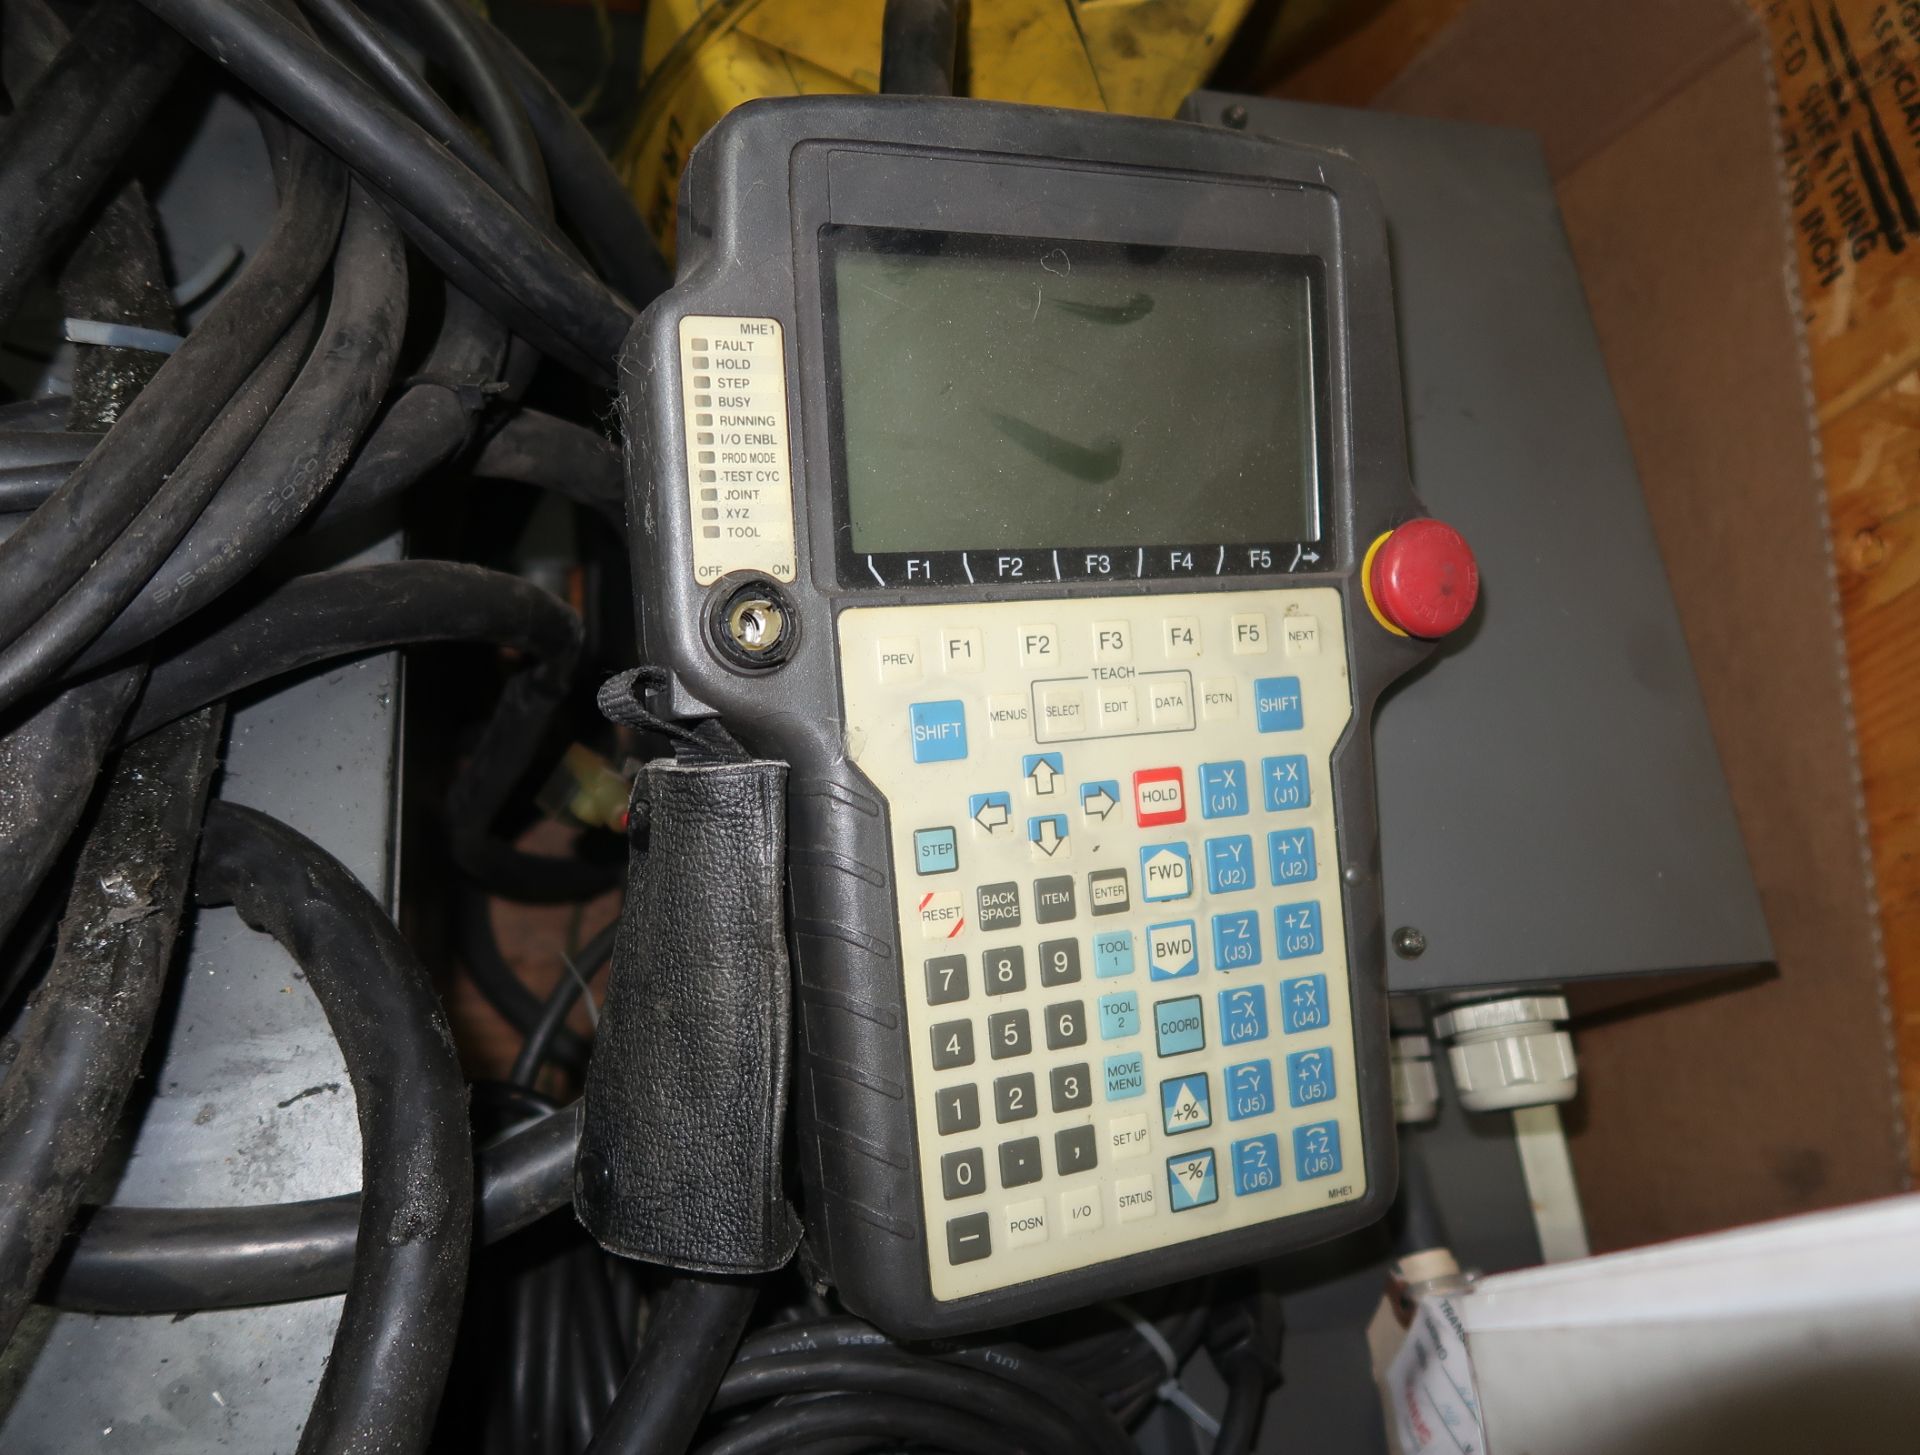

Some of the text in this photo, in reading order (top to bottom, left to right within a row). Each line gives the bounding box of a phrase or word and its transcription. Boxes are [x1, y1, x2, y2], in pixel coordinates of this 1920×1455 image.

[740, 324, 775, 336] MHE1
[715, 341, 754, 352] FAULT
[717, 359, 750, 370] HOLD
[718, 378, 750, 389] STEP
[718, 397, 750, 408] BUSY
[720, 416, 776, 427] RUNNING
[721, 434, 777, 445] I/O ENBL
[722, 453, 776, 464] PROD MODE
[724, 470, 780, 482] TEST CYC
[725, 490, 760, 500] JOINT
[727, 509, 750, 519] XYZ
[727, 527, 760, 538] TOOL
[699, 566, 722, 577] OFF
[772, 565, 790, 575] ON
[907, 551, 1271, 580] F1 F2 F3 F4 F5
[882, 624, 1314, 667] PREV F1 F2 F3 F4 F5 NEXT
[1091, 667, 1135, 680] TEACH
[1105, 700, 1128, 713] EDIT
[1155, 696, 1183, 709] DATA
[1205, 692, 1232, 705] FCTN
[1260, 696, 1298, 712] SHIFT
[990, 709, 1027, 722] MENUS
[1046, 704, 1080, 718] SELECT
[915, 723, 960, 741] SHIFT
[1273, 765, 1297, 781] +X
[1142, 788, 1177, 803] HOLD
[1212, 793, 1237, 812] (J1)
[1274, 787, 1299, 806] (J1)
[921, 843, 952, 857] STEP
[1279, 837, 1303, 855] +Y
[1149, 864, 1183, 880] FWD
[1218, 867, 1247, 885] (J2)
[1280, 860, 1308, 879] (J2)
[1041, 892, 1070, 905] ITEM
[1095, 884, 1124, 898] ENTER
[982, 892, 1016, 907] BACK
[922, 906, 960, 922] RESET
[980, 904, 1019, 920] SPACE
[1285, 910, 1311, 930] +Z
[1098, 941, 1129, 954] TOOL
[1156, 939, 1192, 957] BWD
[1286, 933, 1315, 952] (J3)
[1224, 942, 1253, 961] (J3)
[1053, 952, 1068, 973] 9
[1113, 957, 1118, 966] 1
[998, 960, 1013, 981] 8
[940, 970, 953, 991] 7
[1103, 1002, 1135, 1015] TOOL
[1292, 992, 1318, 1009] +X
[1059, 1015, 1073, 1036] 6
[1118, 1017, 1125, 1028] 2
[1160, 1017, 1200, 1035] COORD
[1292, 1009, 1321, 1027] (J4)
[1004, 1024, 1018, 1046] 5
[1231, 1021, 1259, 1040] (J4)
[946, 1034, 960, 1056] 4
[1107, 1062, 1141, 1077] MOVE
[1299, 1064, 1322, 1081] +Y
[1064, 1078, 1079, 1099] 3
[1108, 1075, 1142, 1091] MENU
[1299, 1082, 1327, 1100] (J5)
[1009, 1088, 1024, 1110] 2
[1238, 1094, 1266, 1114] (J5)
[952, 1099, 962, 1120] 1
[1173, 1102, 1199, 1121] +%
[1113, 1129, 1147, 1147] SET UP
[1306, 1137, 1330, 1155] +Z
[1305, 1155, 1334, 1173] (J6)
[956, 1163, 972, 1184] 0
[1243, 1169, 1273, 1189] (J6)
[1119, 1189, 1153, 1208] STATUS
[1328, 1186, 1353, 1200] MHE1
[1072, 1204, 1092, 1219] I/O
[1009, 1216, 1044, 1235] POSN
